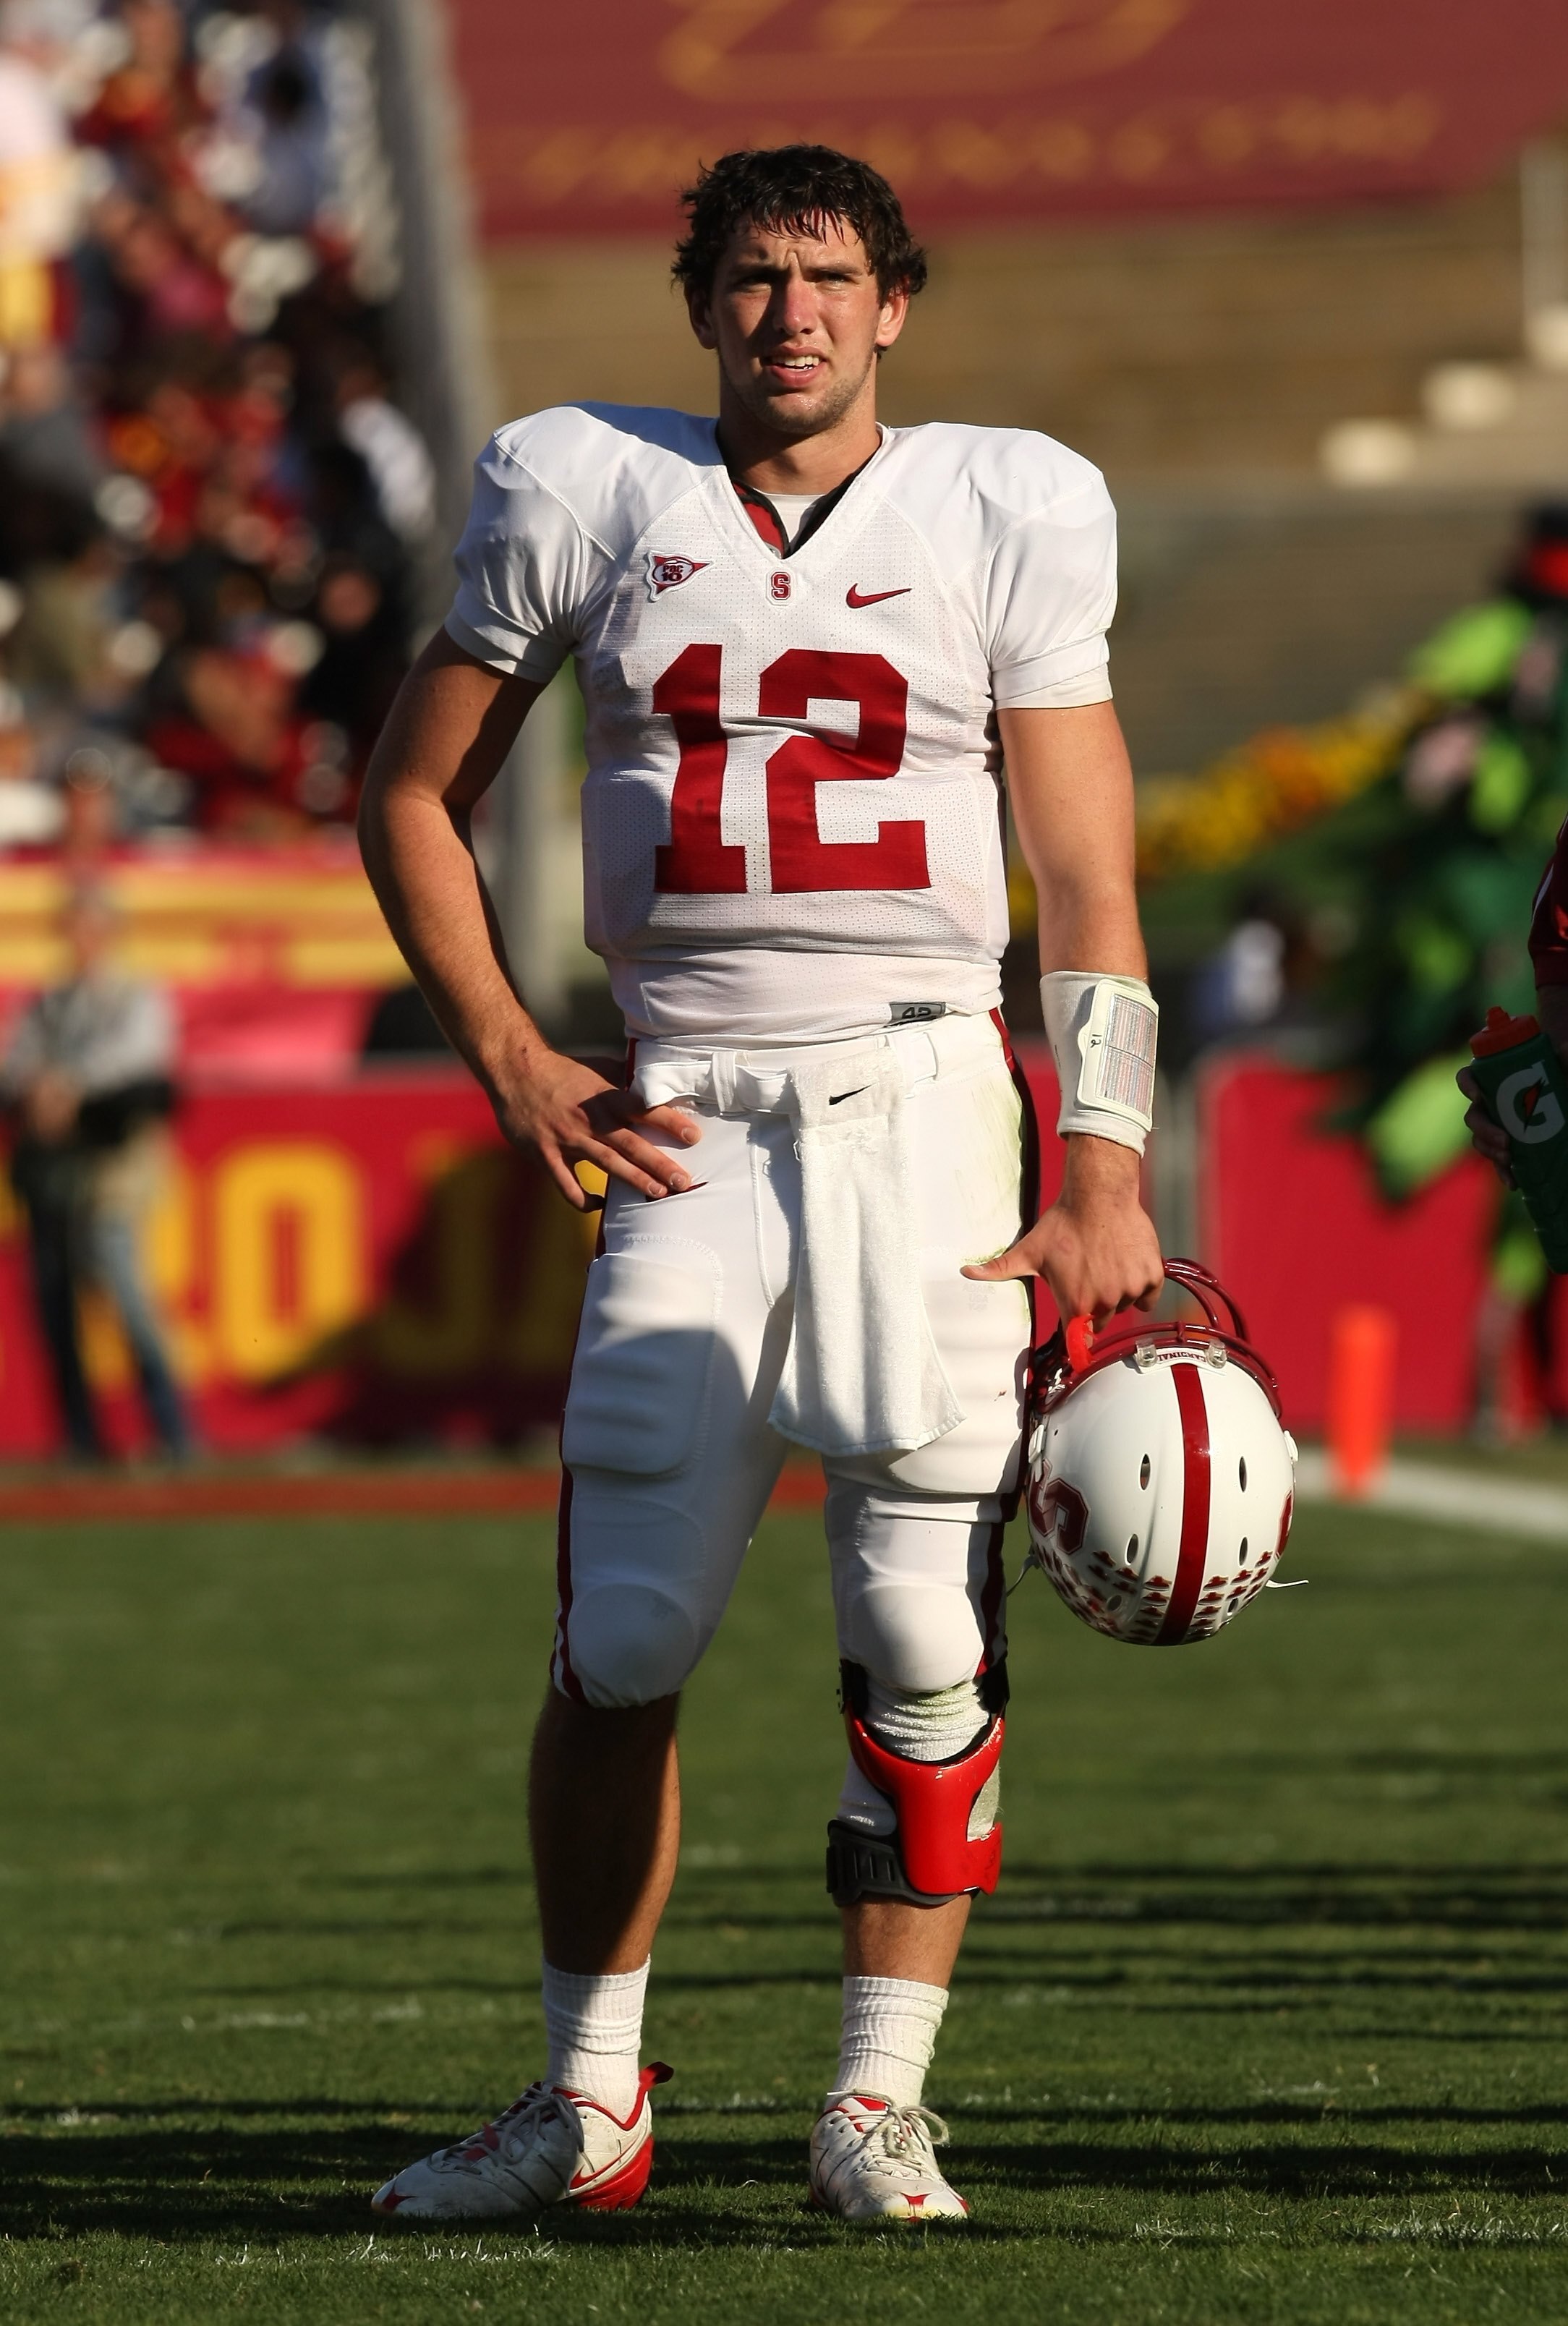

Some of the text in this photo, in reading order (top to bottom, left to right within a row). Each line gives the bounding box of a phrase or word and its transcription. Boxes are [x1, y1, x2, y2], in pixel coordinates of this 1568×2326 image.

[662, 572, 683, 582] 10
[771, 571, 791, 600] S
[651, 643, 931, 893] 12
[1091, 1034, 1102, 1048] 12
[1496, 1060, 1565, 1143] G
